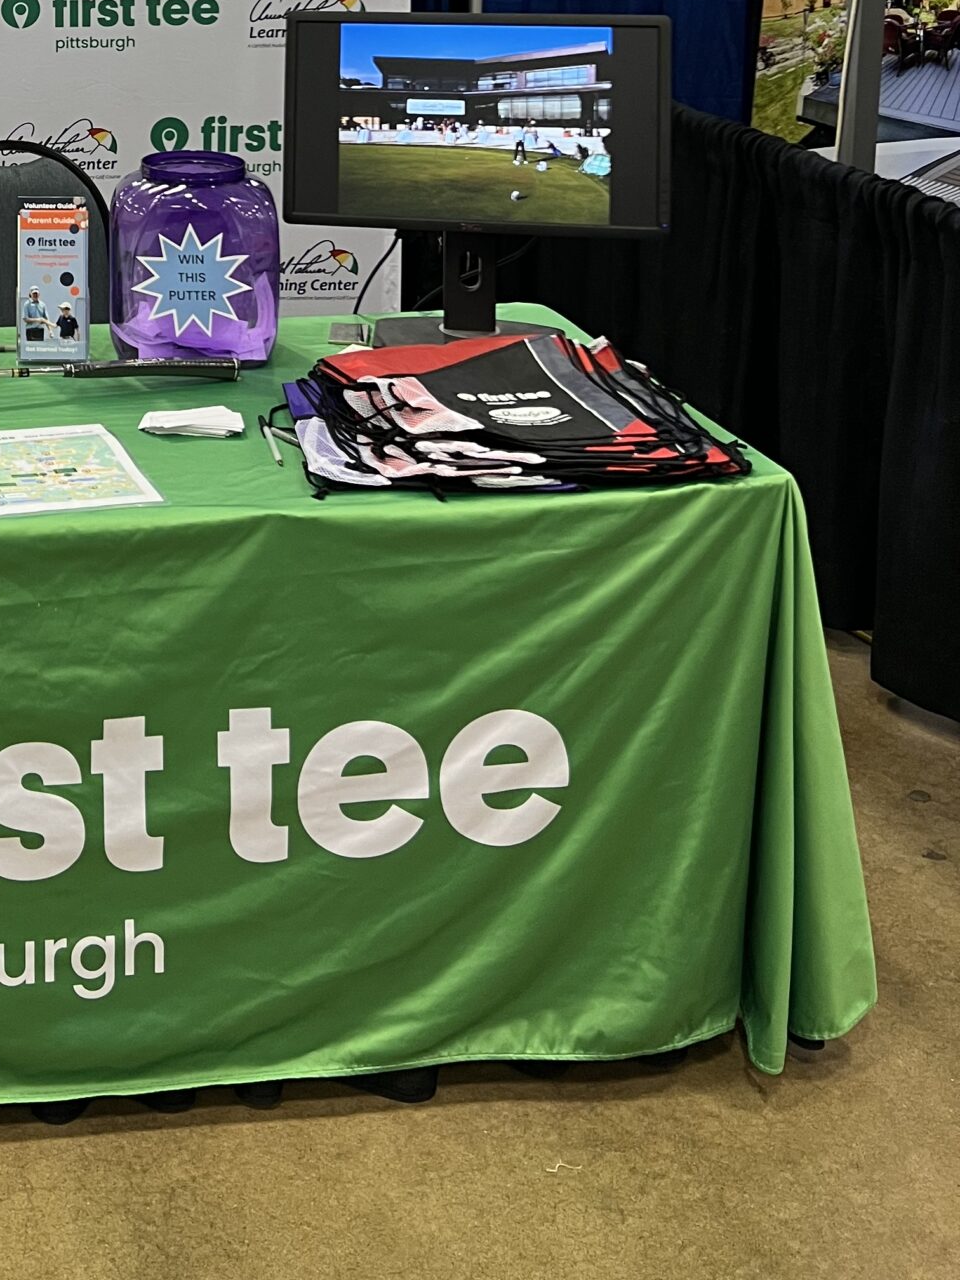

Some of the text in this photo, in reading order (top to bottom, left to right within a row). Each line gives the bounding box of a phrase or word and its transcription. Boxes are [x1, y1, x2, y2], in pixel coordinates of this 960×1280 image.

[250, 27, 287, 38] Learn
[56, 36, 135, 53] pittsburgh
[201, 116, 282, 152] first
[37, 237, 76, 247] first tee
[178, 255, 204, 264] WIN
[178, 273, 206, 283] THIS
[311, 279, 359, 291] Center
[169, 291, 216, 301] PUTTER
[218, 708, 570, 862] tee
